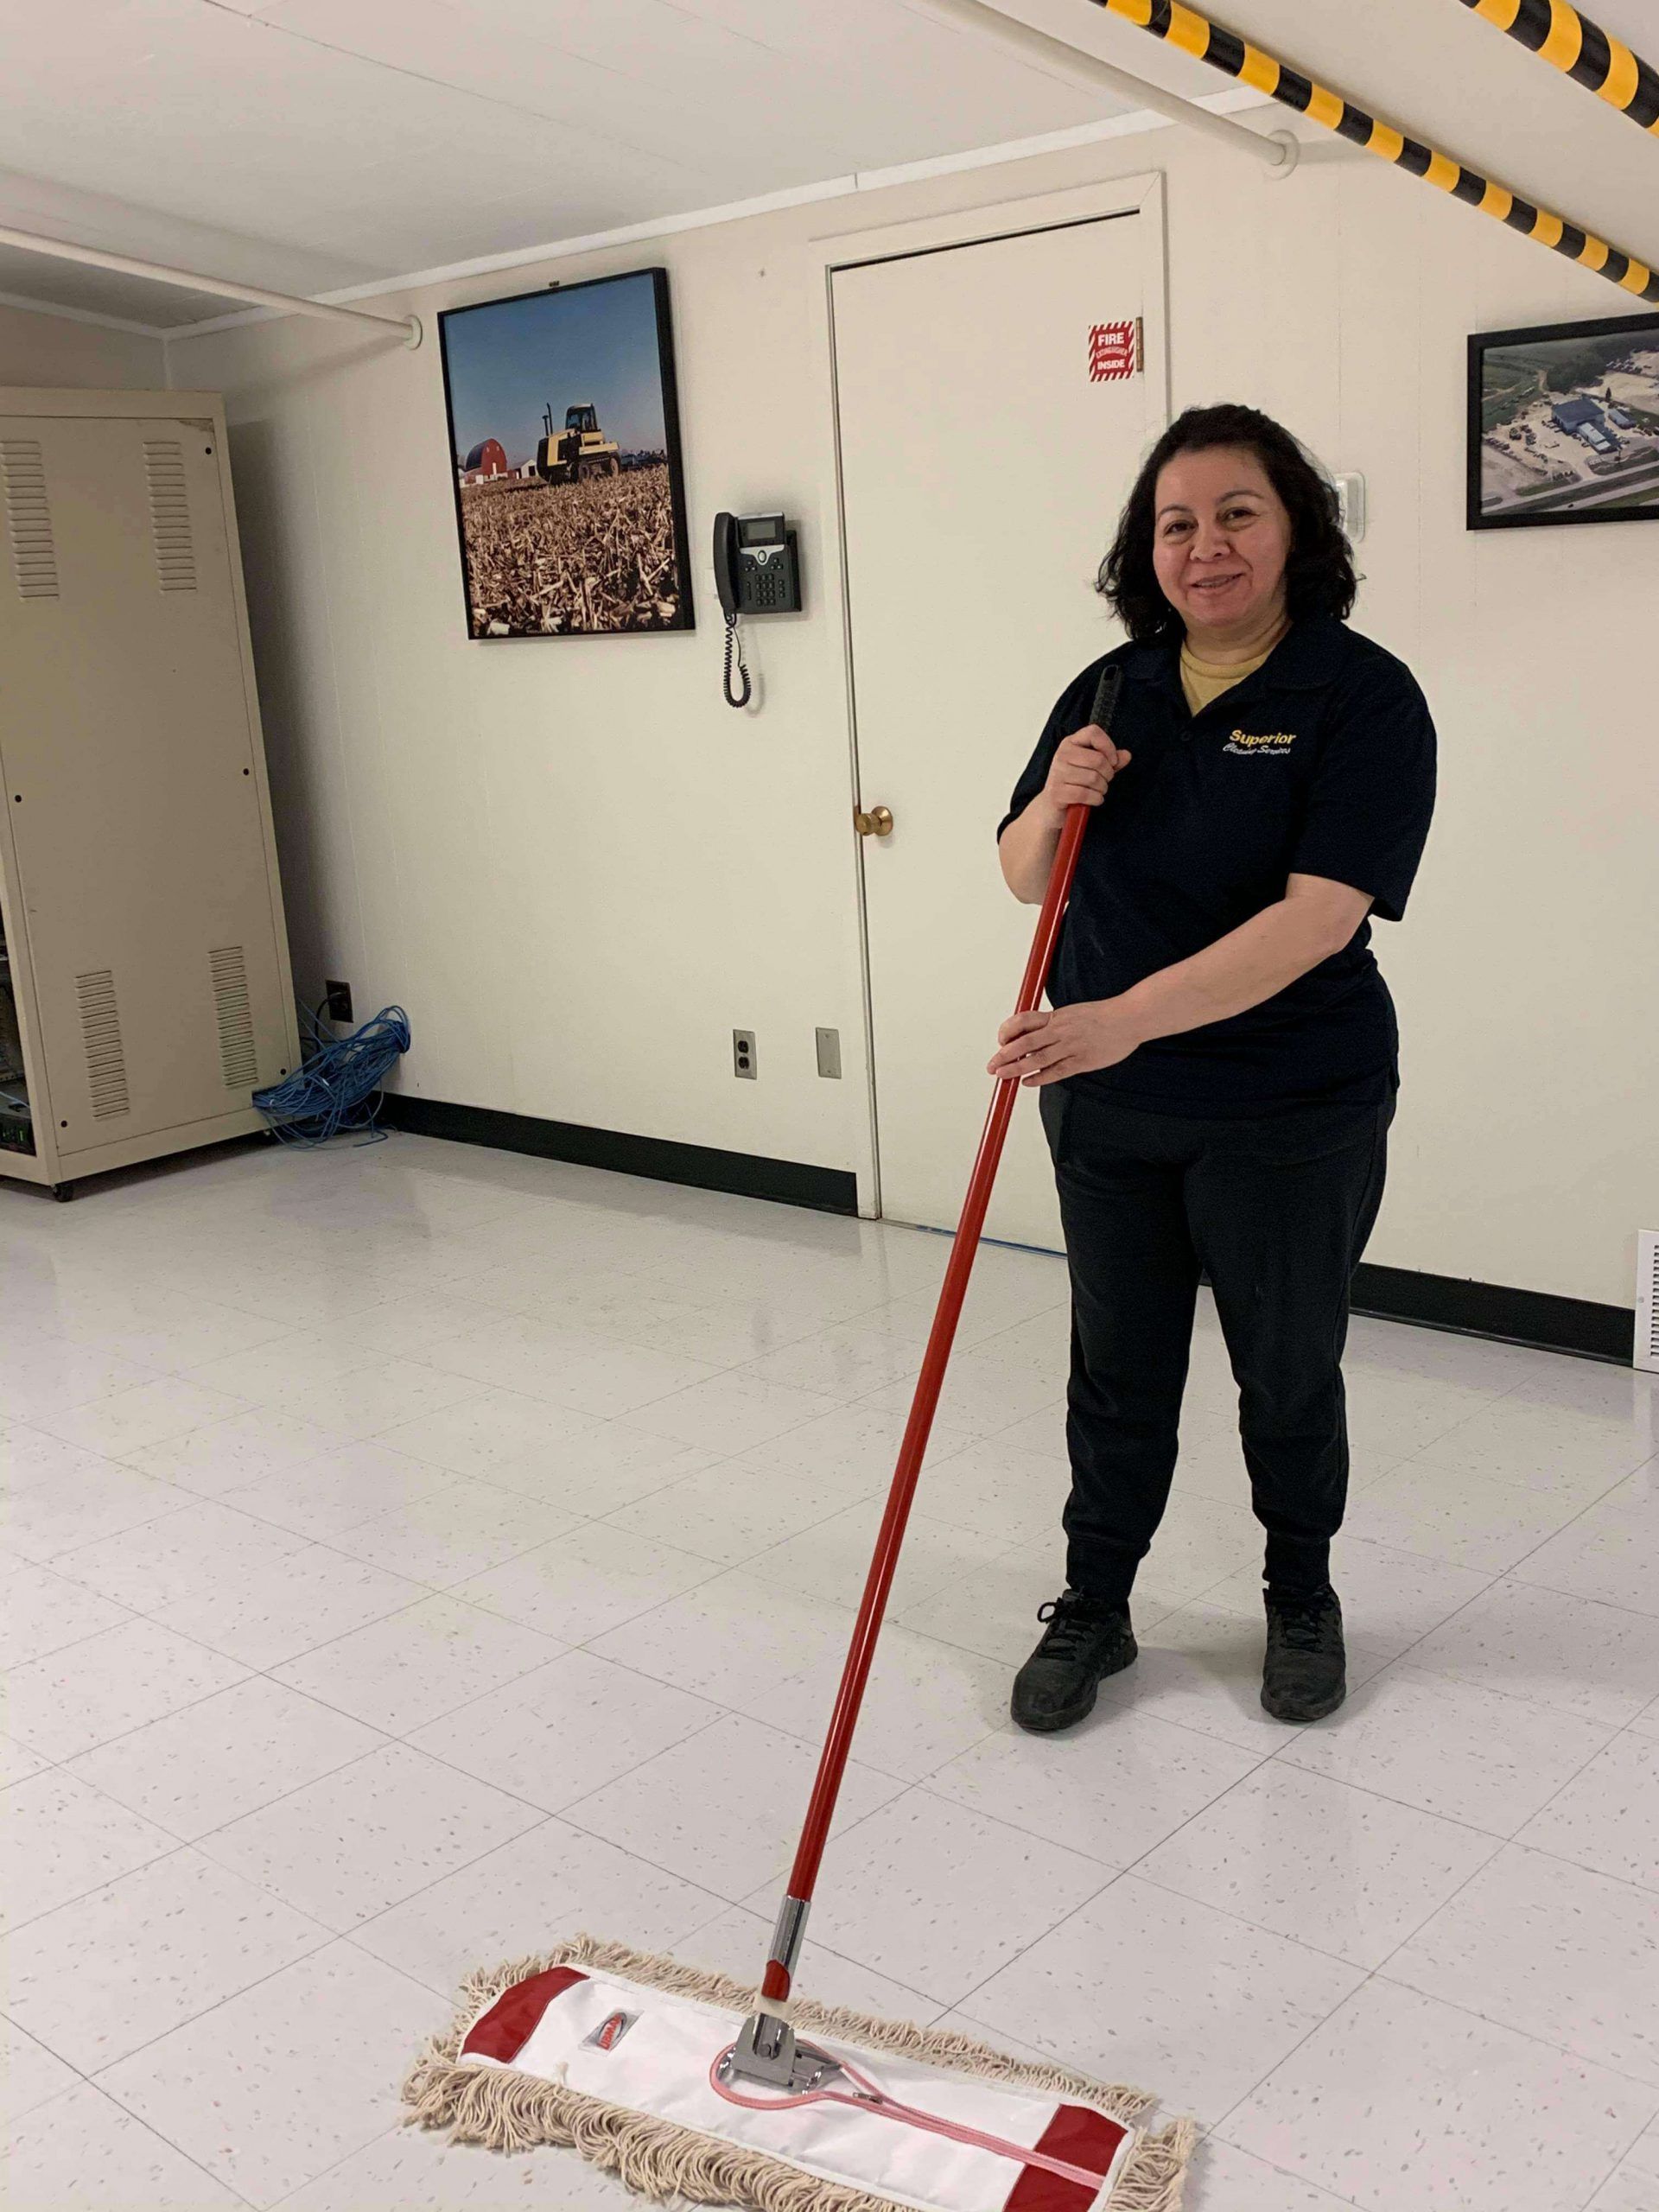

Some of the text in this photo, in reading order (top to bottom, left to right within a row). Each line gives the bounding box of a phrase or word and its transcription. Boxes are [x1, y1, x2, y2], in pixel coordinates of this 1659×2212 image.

[1097, 332, 1124, 346] FIRE
[1096, 359, 1125, 370] INSIDE
[1229, 729, 1296, 747] Superior
